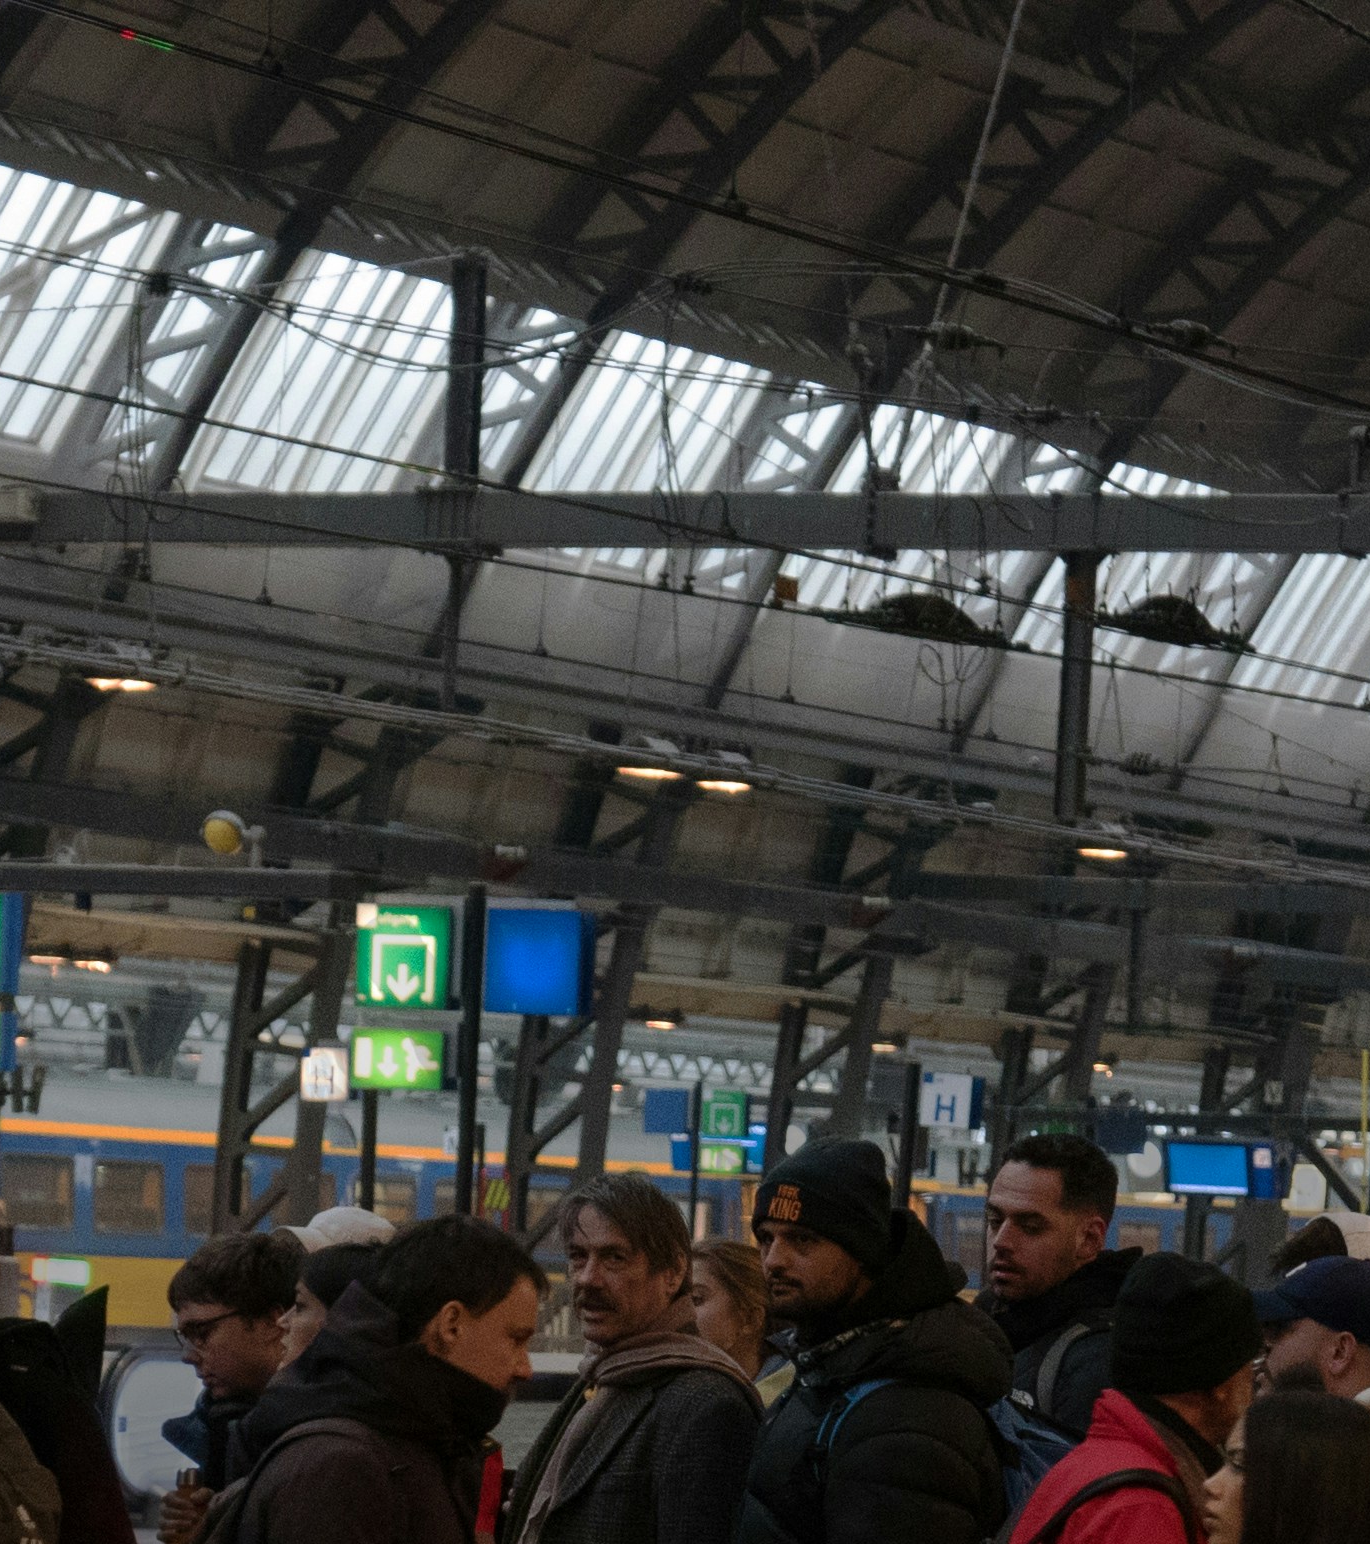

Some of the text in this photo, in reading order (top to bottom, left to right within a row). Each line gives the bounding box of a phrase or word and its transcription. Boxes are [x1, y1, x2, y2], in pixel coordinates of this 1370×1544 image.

[314, 1064, 335, 1096] H
[934, 1093, 957, 1123] H
[767, 1196, 802, 1222] KING
